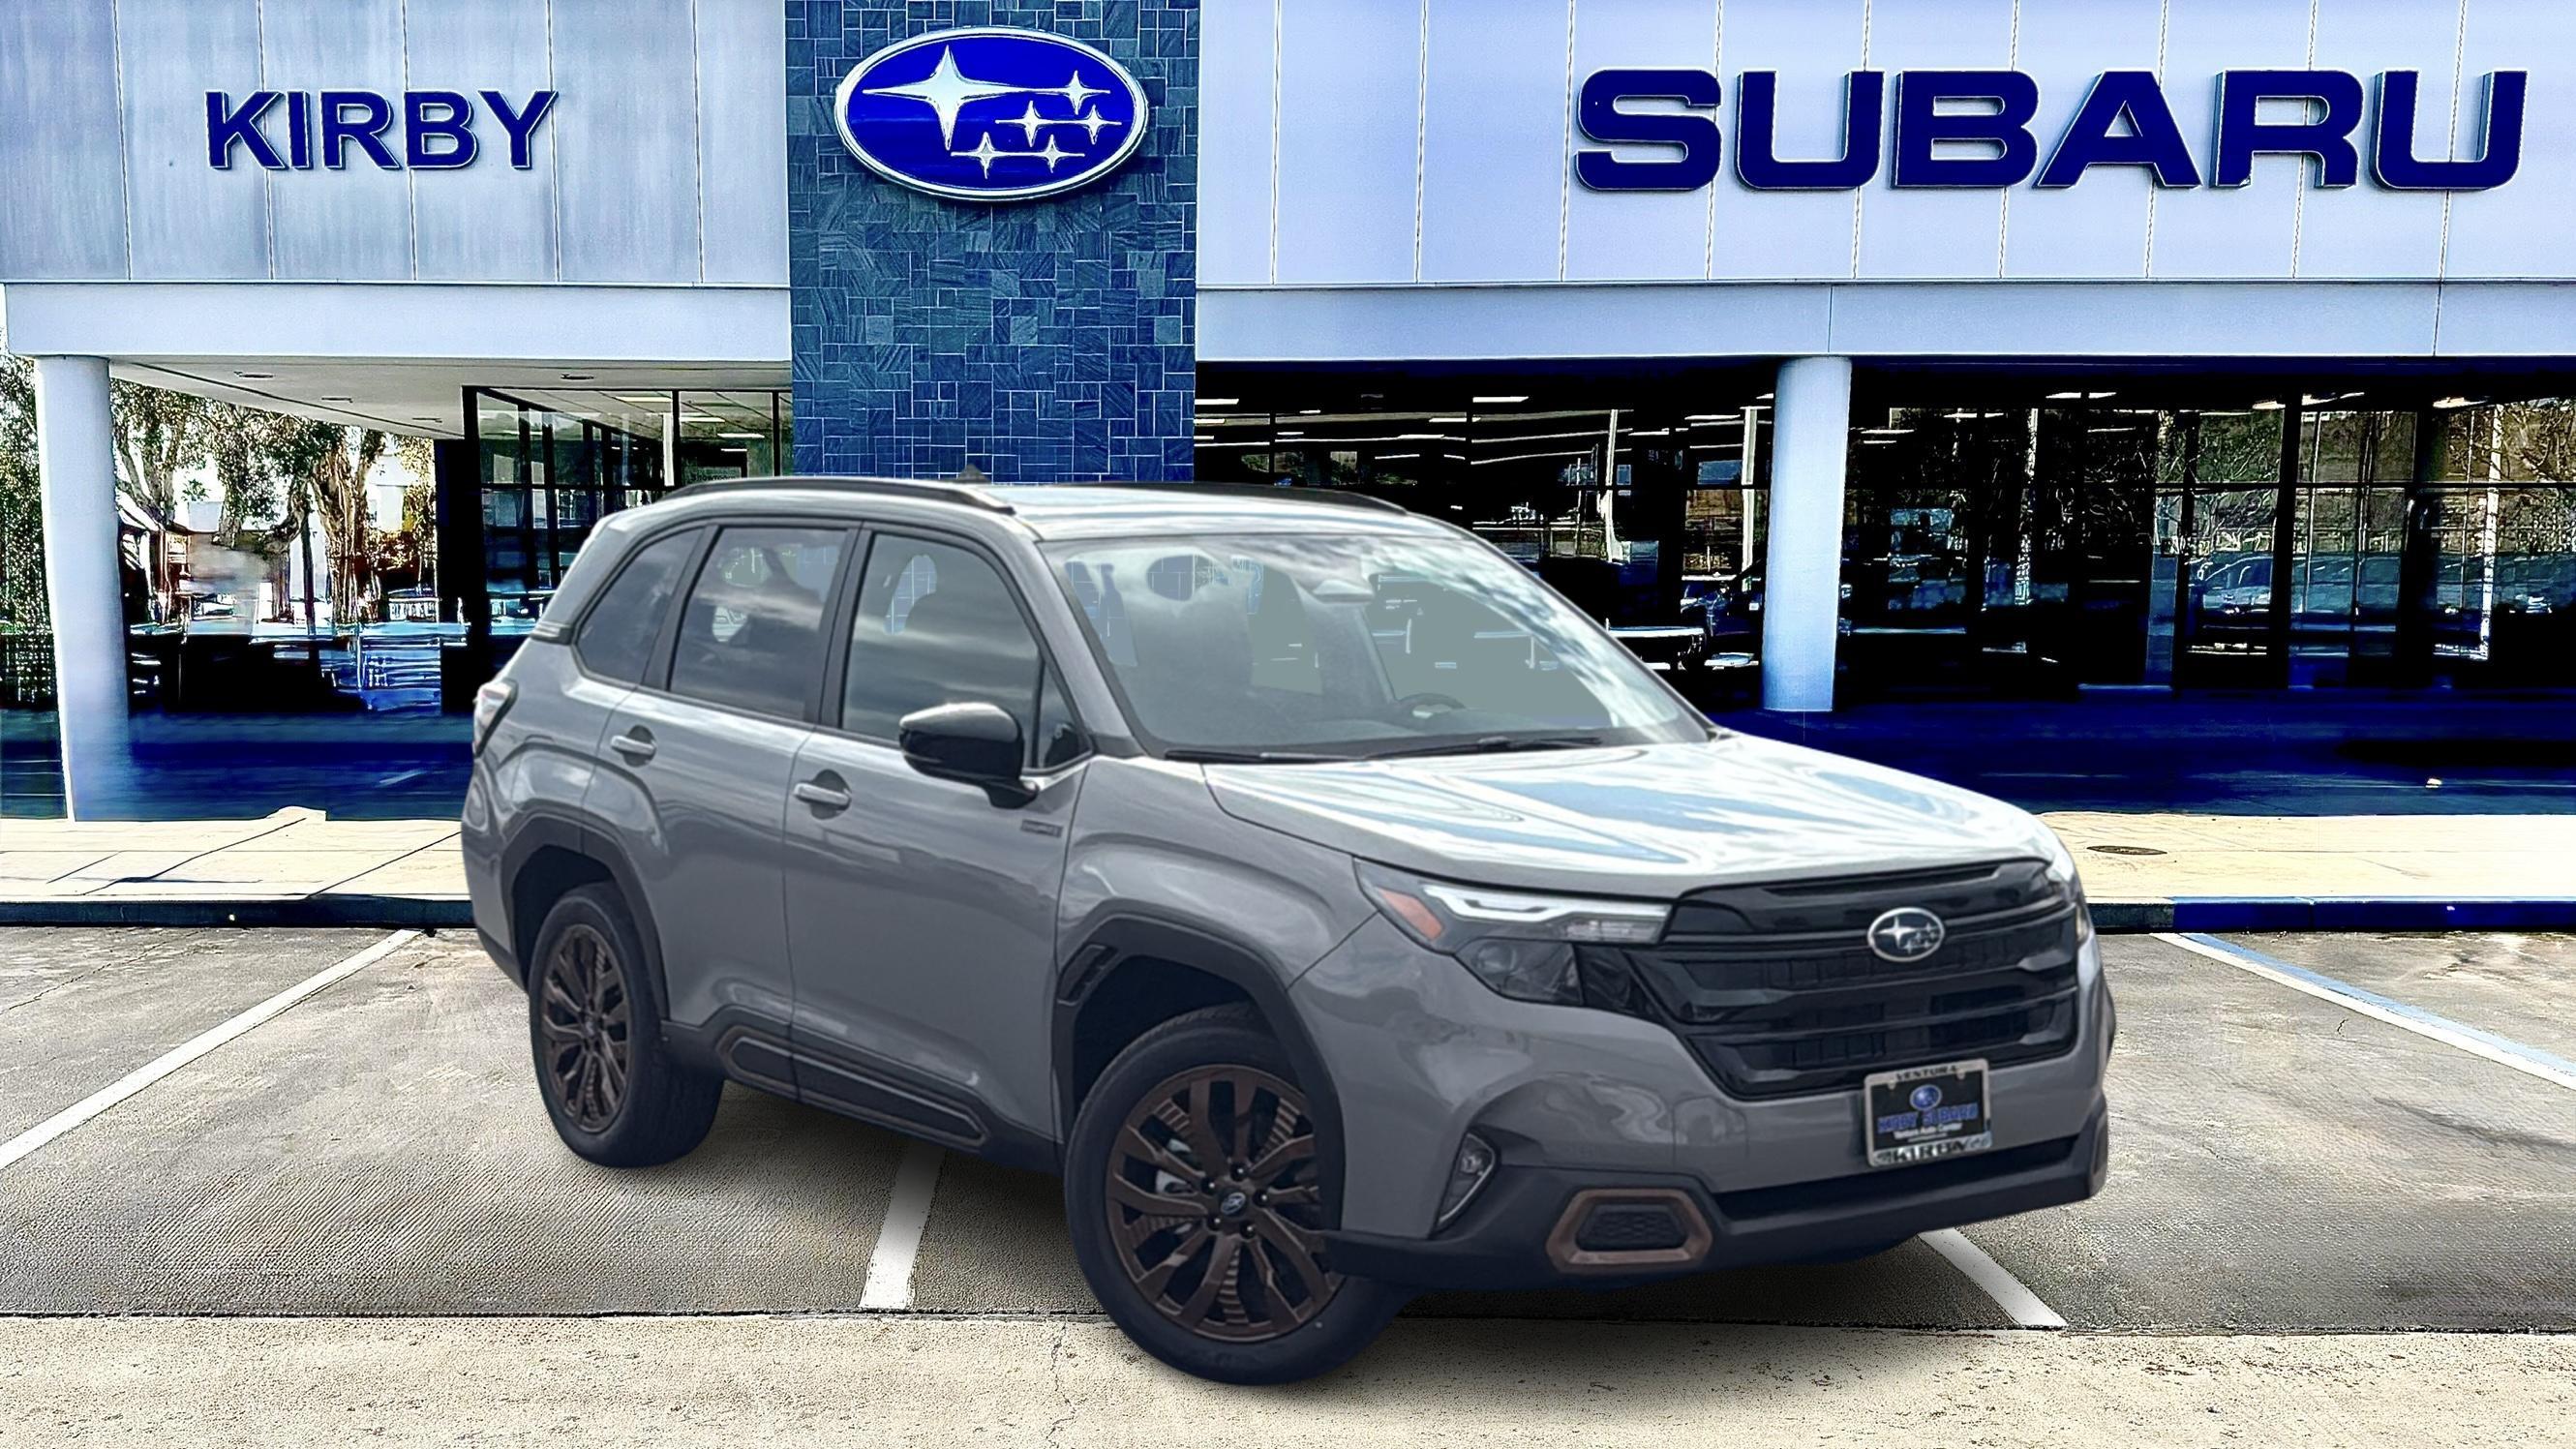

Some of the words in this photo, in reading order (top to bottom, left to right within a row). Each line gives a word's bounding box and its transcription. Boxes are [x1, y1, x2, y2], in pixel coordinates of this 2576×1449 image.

[204, 89, 560, 169] KIRBY
[1575, 69, 2527, 190] SUBARU
[1895, 1065, 1956, 1081] VENTURA
